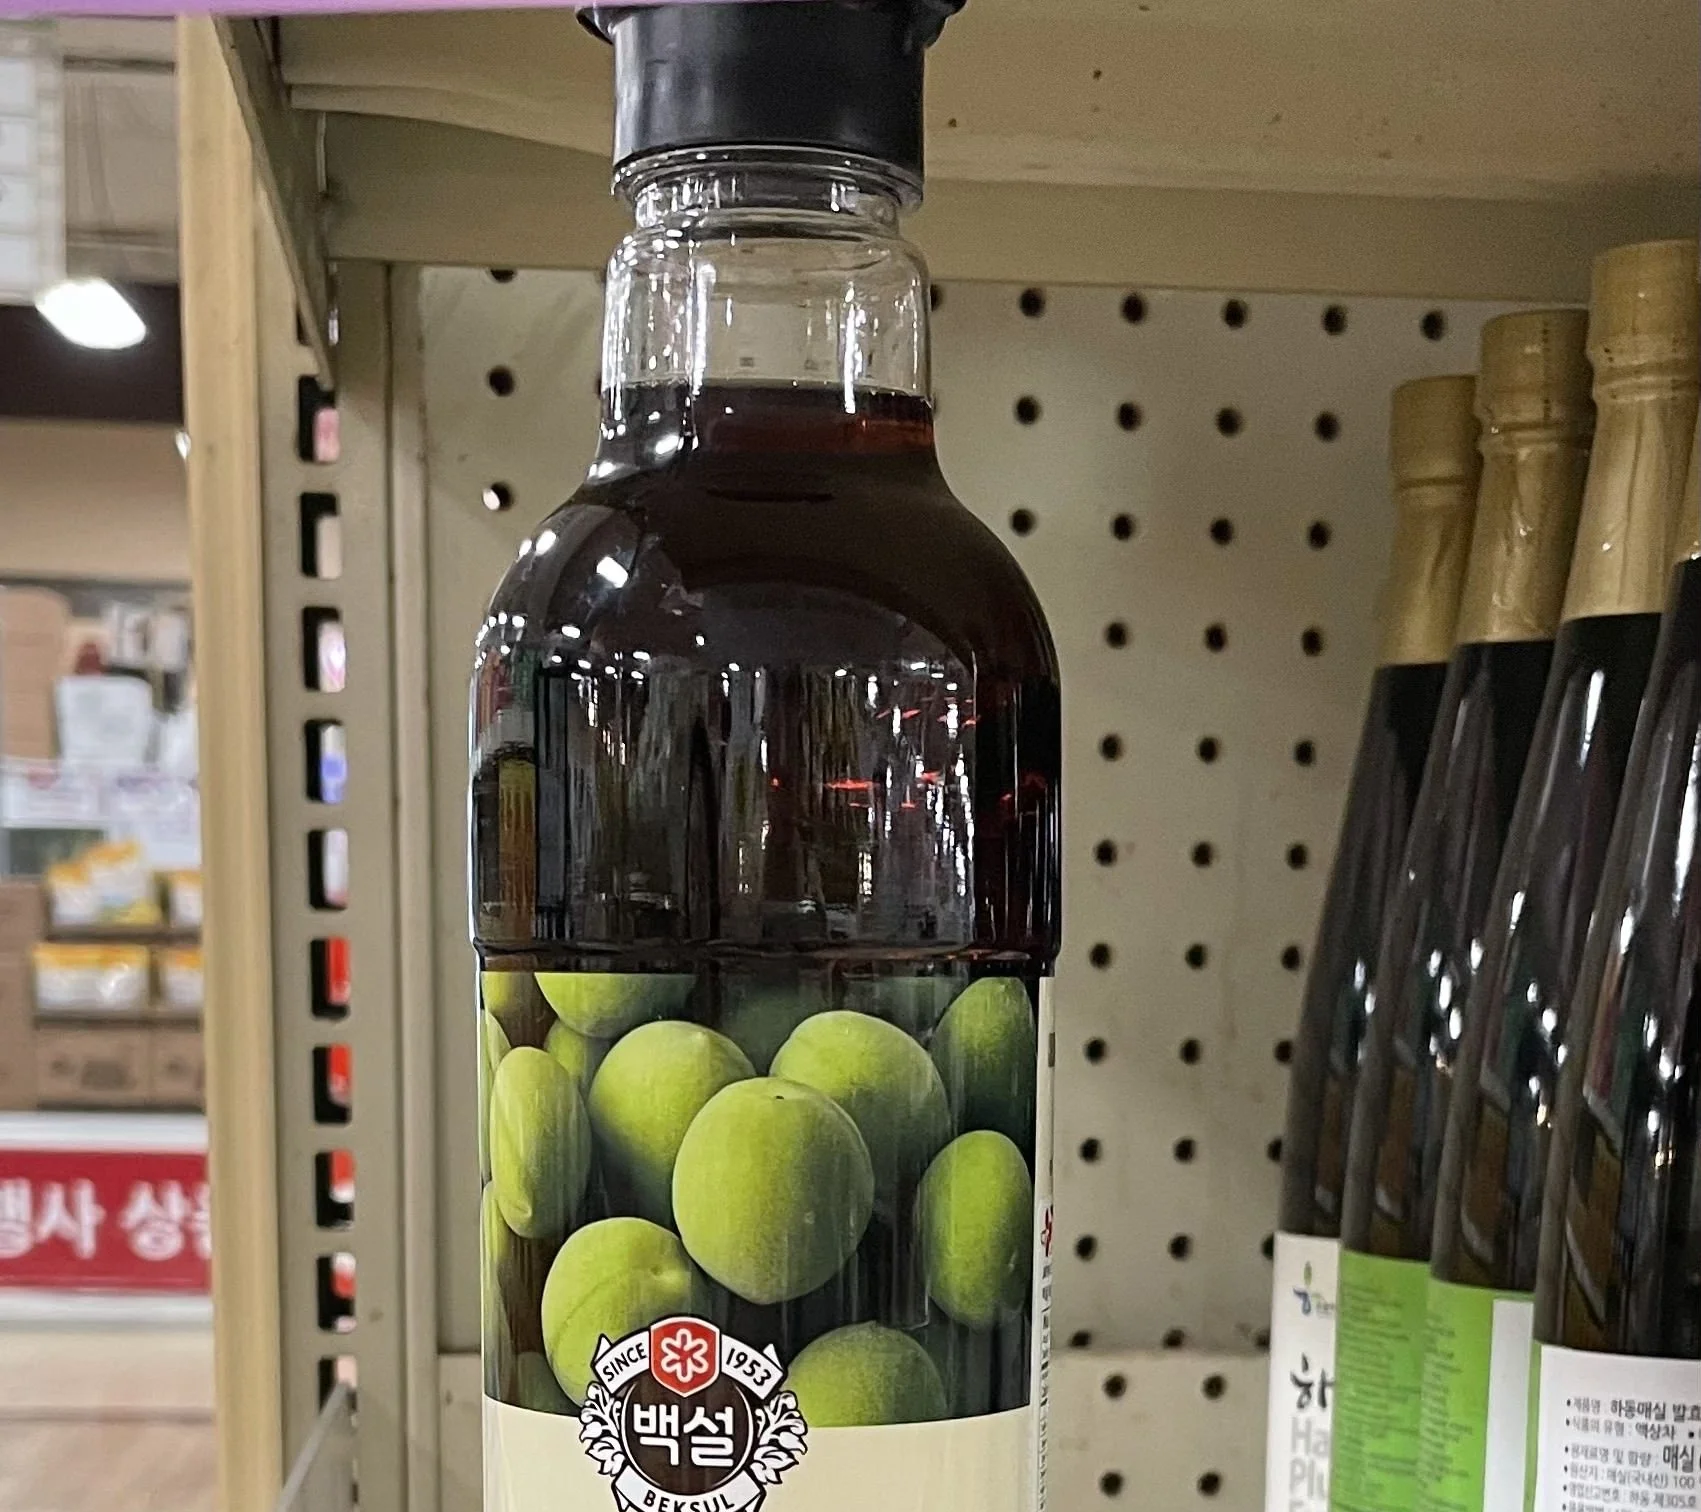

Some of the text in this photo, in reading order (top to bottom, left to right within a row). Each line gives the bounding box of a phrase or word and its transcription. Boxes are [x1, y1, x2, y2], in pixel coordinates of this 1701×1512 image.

[118, 1179, 211, 1261] 상
[602, 1342, 772, 1387] SINCE 1953
[633, 1403, 734, 1467] 백설
[1663, 1444, 1695, 1473] 매실
